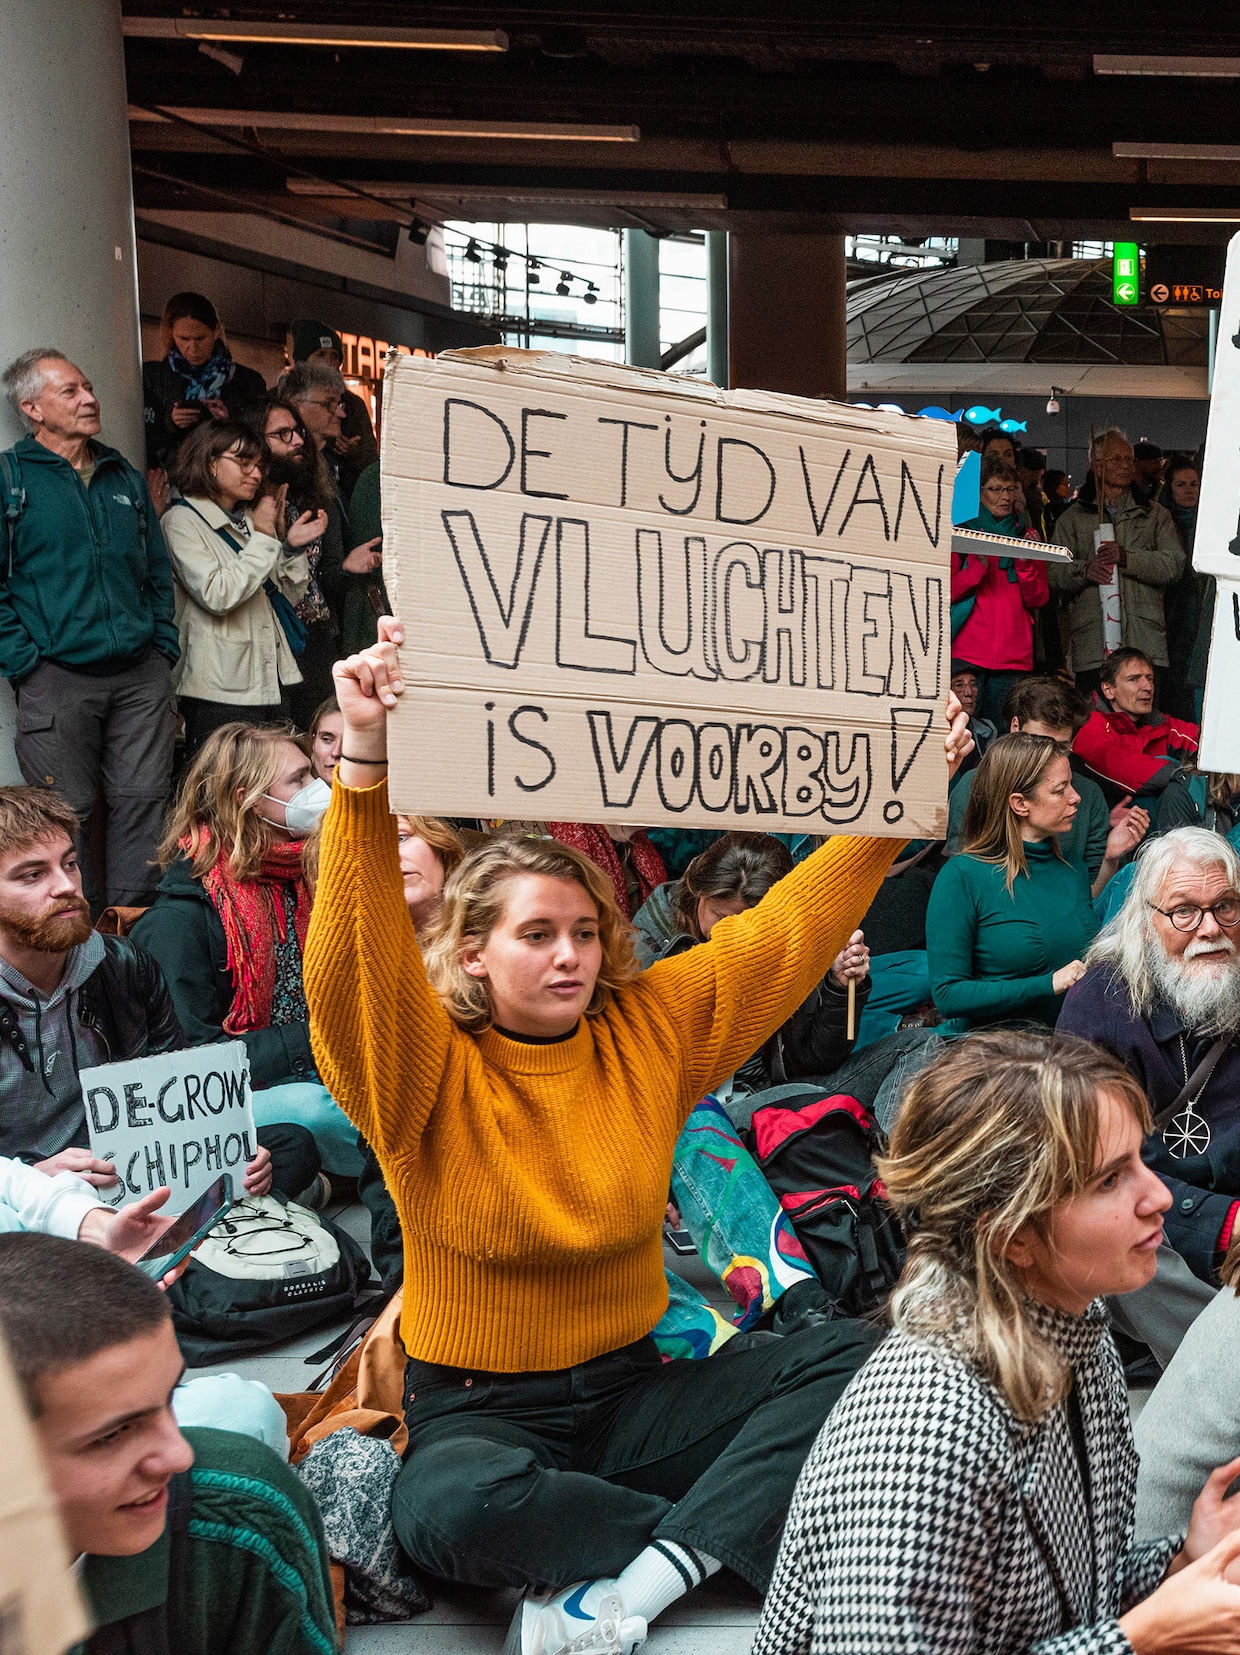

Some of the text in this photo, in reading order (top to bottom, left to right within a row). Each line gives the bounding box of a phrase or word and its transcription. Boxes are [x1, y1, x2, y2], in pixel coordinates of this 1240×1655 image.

[1205, 288, 1225, 298] Toi
[443, 397, 569, 501] DE
[799, 445, 945, 548] VAN
[441, 509, 944, 700] VLUCHTEN
